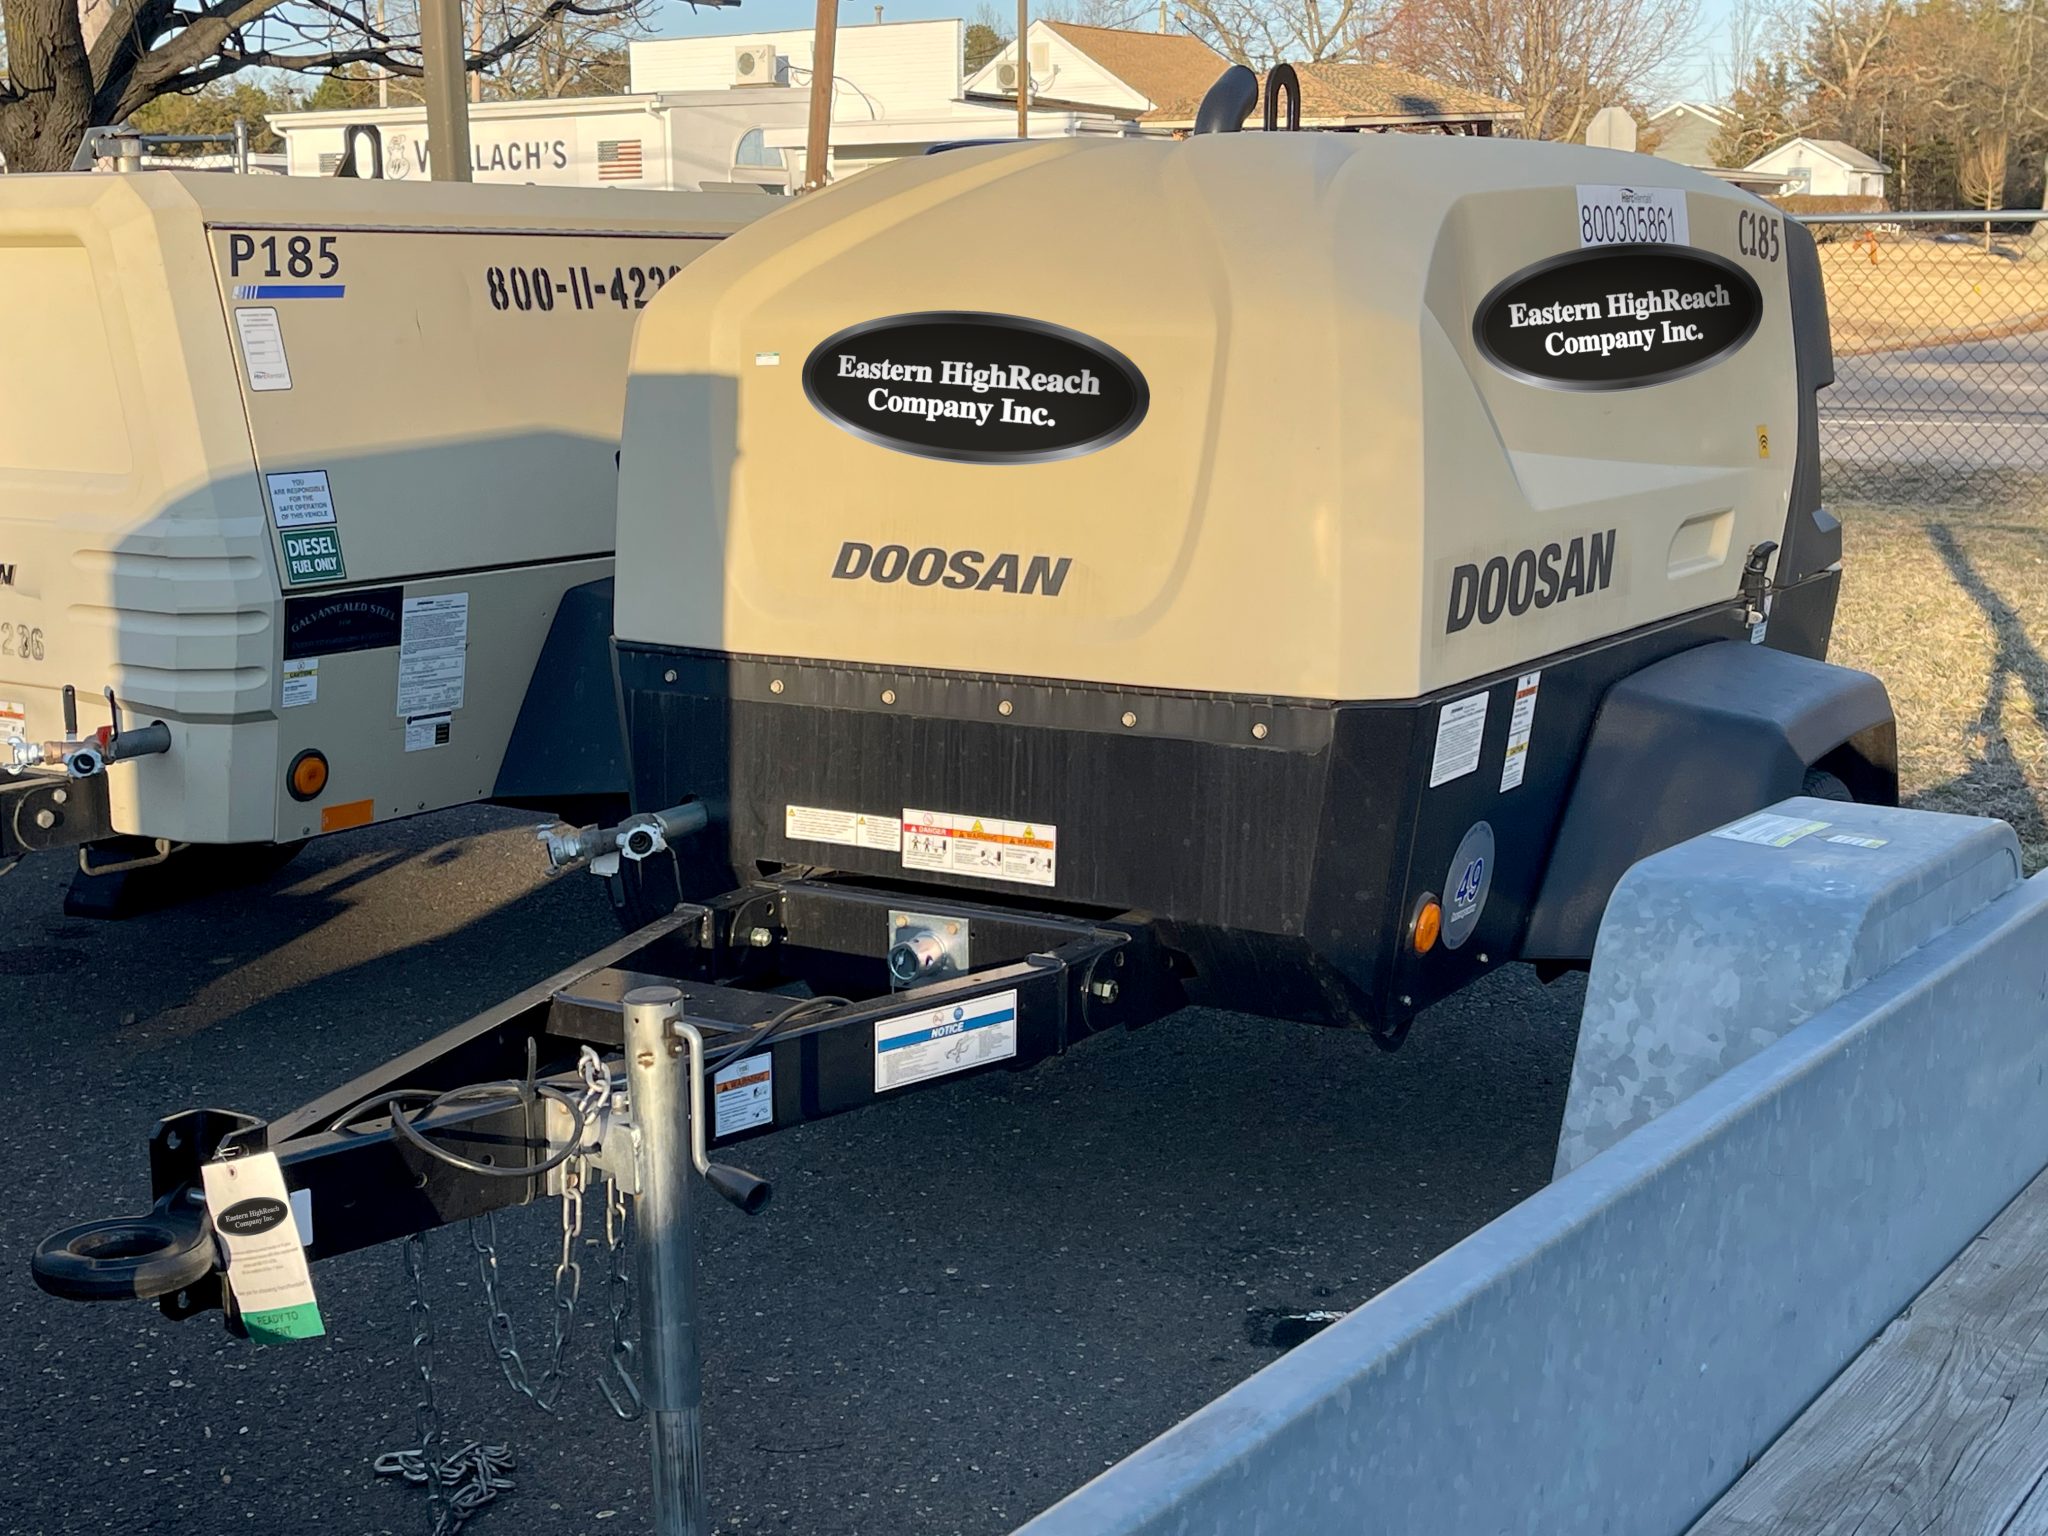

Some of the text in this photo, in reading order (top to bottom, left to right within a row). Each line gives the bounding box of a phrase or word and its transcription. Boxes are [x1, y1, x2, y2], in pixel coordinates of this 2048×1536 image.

[1582, 205, 1675, 243] 800305861
[1738, 210, 1779, 262] C185
[230, 233, 339, 279] P185
[1508, 284, 1731, 328] Eastern HighReach
[1545, 320, 1704, 356] Company Inc.
[837, 355, 1100, 395] Eastern HighReach
[868, 388, 1056, 427] Company Inc.
[295, 502, 328, 511] OPERATION
[304, 510, 328, 519] VEHICLE
[287, 537, 336, 557] DIESEL
[292, 557, 337, 574] FUEL ONLY
[832, 541, 1073, 597] DOOSAN
[1446, 528, 1617, 635] DOOSAN
[919, 826, 947, 835] DANGER
[1454, 857, 1484, 907] 49
[931, 1021, 965, 1039] NOTICE
[225, 1205, 280, 1223] Eastern HighReach
[234, 1214, 275, 1229] Company Inc.
[257, 1310, 299, 1325] READY TO
